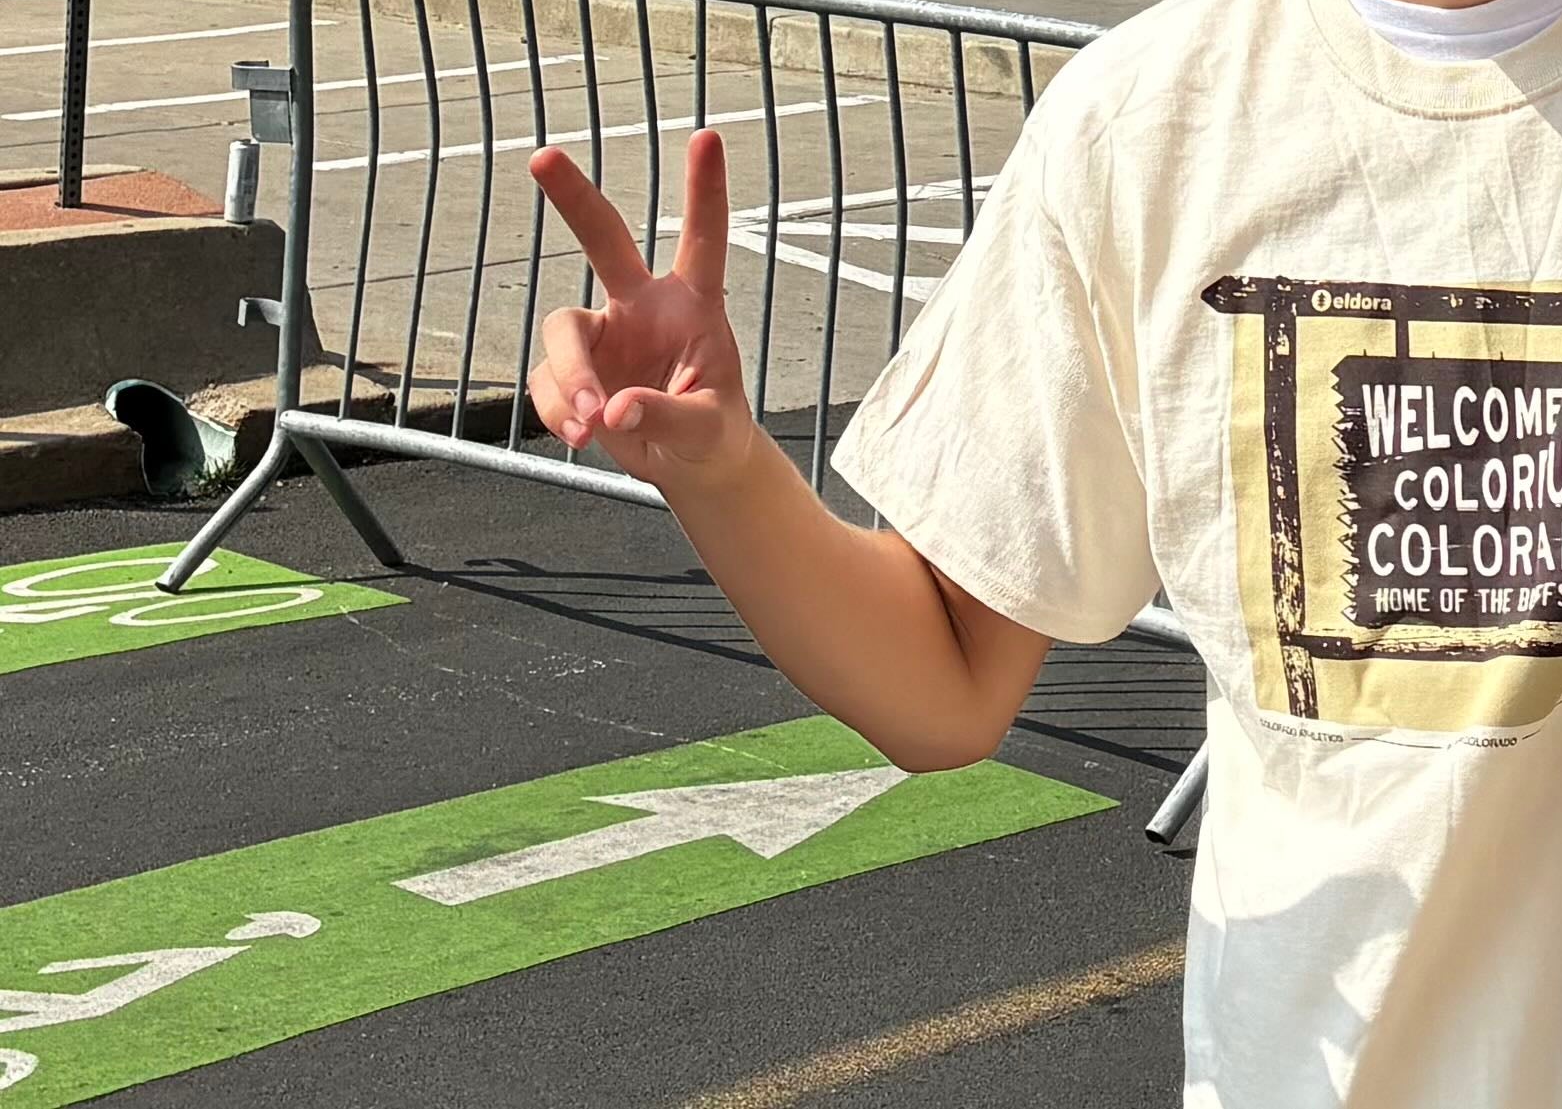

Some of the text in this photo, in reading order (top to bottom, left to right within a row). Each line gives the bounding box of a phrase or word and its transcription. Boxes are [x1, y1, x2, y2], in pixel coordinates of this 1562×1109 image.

[1333, 292, 1392, 311] eldora
[1374, 587, 1430, 613] HOME
[1440, 588, 1465, 613] OF
[1477, 587, 1514, 613] THE
